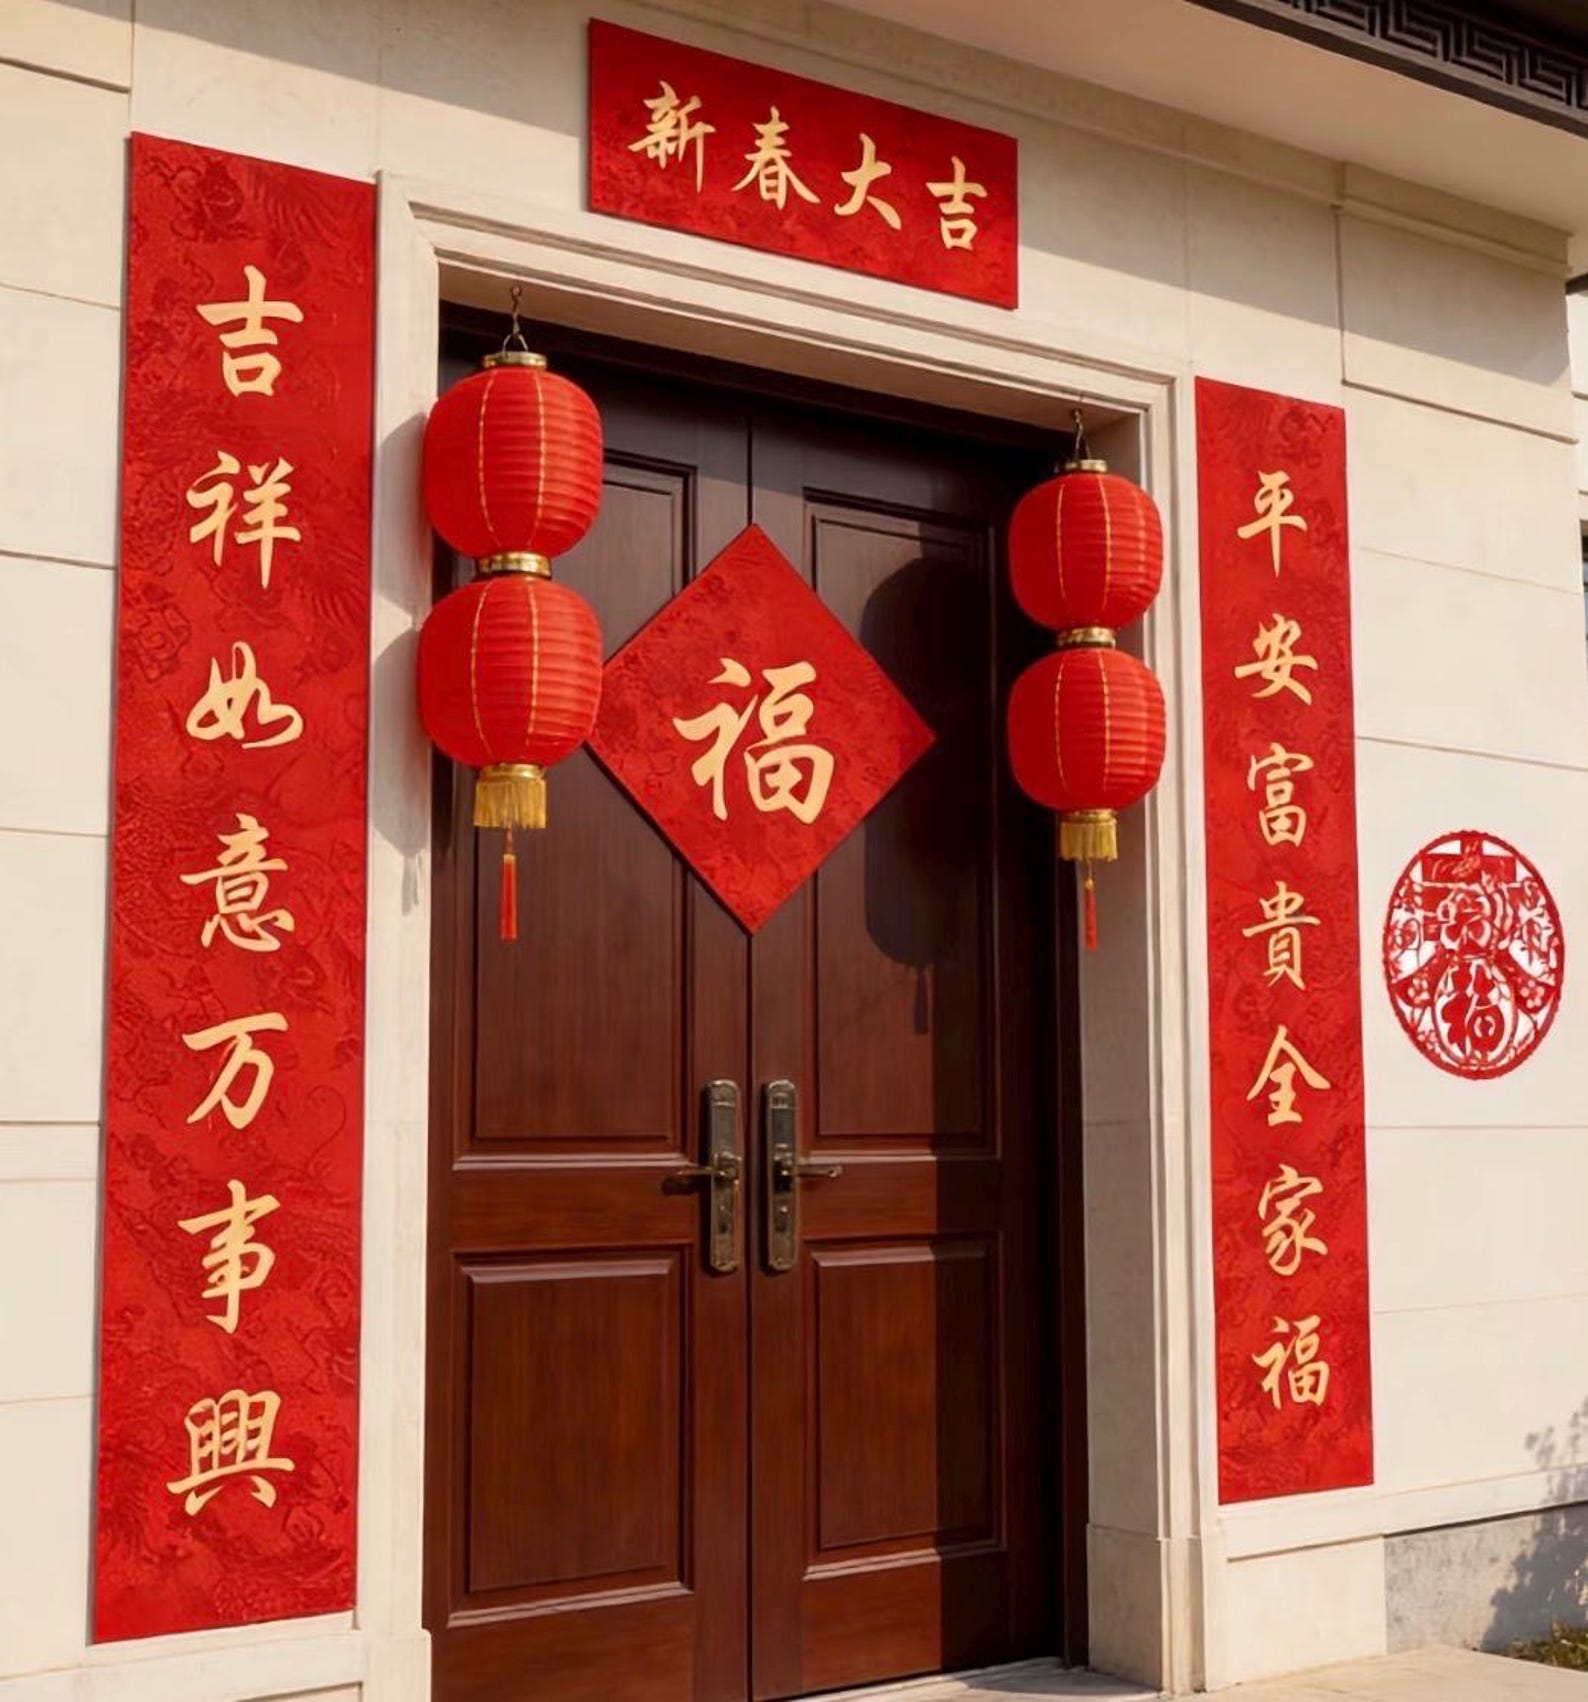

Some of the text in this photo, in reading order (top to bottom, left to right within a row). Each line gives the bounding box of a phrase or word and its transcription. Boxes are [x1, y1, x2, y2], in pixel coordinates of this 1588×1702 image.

[628, 80, 988, 250] 新春大吉
[166, 265, 304, 1515] 吉祥如意万事興
[672, 657, 835, 824] 福
[1234, 470, 1331, 1410] 平安富貴全家福
